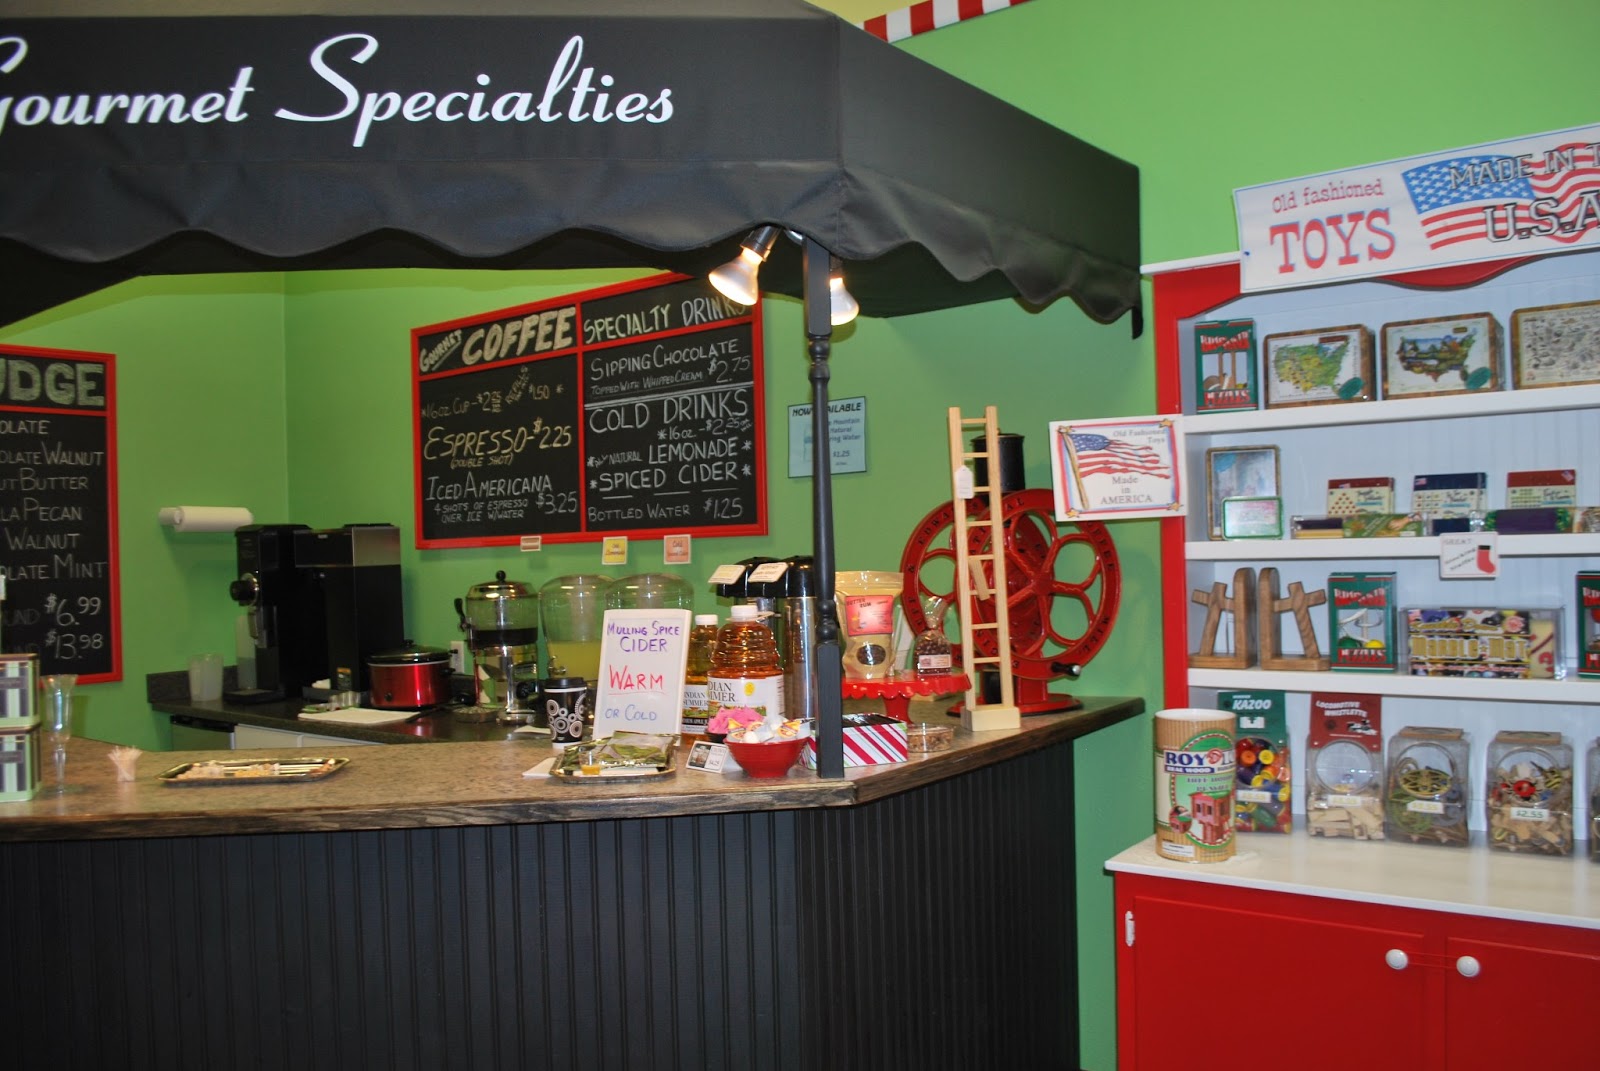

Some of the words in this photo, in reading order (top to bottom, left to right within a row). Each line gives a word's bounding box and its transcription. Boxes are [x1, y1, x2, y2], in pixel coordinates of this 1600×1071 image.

[275, 34, 674, 147] Specialties
[1449, 154, 1534, 191] MADE
[1544, 147, 1576, 174] IN
[1272, 194, 1298, 214] Old
[1303, 178, 1384, 206] fashioned
[1269, 207, 1396, 274] TOYS
[584, 303, 670, 344] SPECIALTY
[419, 329, 463, 372] GOURMET
[461, 306, 576, 366] COFFEE
[591, 354, 651, 381] SIPPING
[653, 339, 739, 368] CHOCOLATE
[707, 355, 750, 384] $2.75
[0, 358, 105, 407] DGE
[589, 402, 650, 433] COLD
[663, 389, 749, 424] DRINKS
[827, 402, 862, 413] AILABLE
[42, 441, 104, 467] WALNUT
[424, 426, 528, 460] ESPRESSO
[608, 451, 643, 465] NATURAL
[649, 437, 738, 464] LEMONADE
[450, 457, 484, 470] (DOUBLE
[488, 453, 515, 467] SHOT)
[20, 467, 89, 492] BUTTER
[425, 476, 463, 501] ICED
[463, 471, 553, 499] AMERICANA
[599, 468, 666, 492] SPICED
[678, 461, 738, 484] CIDER
[1112, 476, 1138, 484] Made
[1100, 494, 1153, 505] AMERICA
[1121, 486, 1130, 494] in
[23, 497, 83, 522] PECAN
[441, 513, 463, 524] OVER
[466, 511, 481, 522] ICE
[442, 502, 469, 514] SHOTS
[473, 501, 485, 511] OF
[487, 499, 529, 511] ESPRESSO
[588, 506, 643, 522] BOTTLED
[647, 503, 690, 519] WATER
[703, 497, 743, 519] $1.25
[5, 527, 81, 550] WALNUT
[53, 554, 108, 579] MINT
[44, 592, 101, 627] $6.99
[607, 622, 648, 636] MULLING
[652, 621, 680, 636] SPICE
[45, 629, 104, 661] $13.98
[620, 636, 668, 652] CIDER
[609, 664, 663, 690] WARM
[709, 680, 732, 691] DIAN
[625, 704, 657, 721] COLD
[1231, 699, 1272, 710] KAZOO
[1165, 751, 1205, 766] ROY
